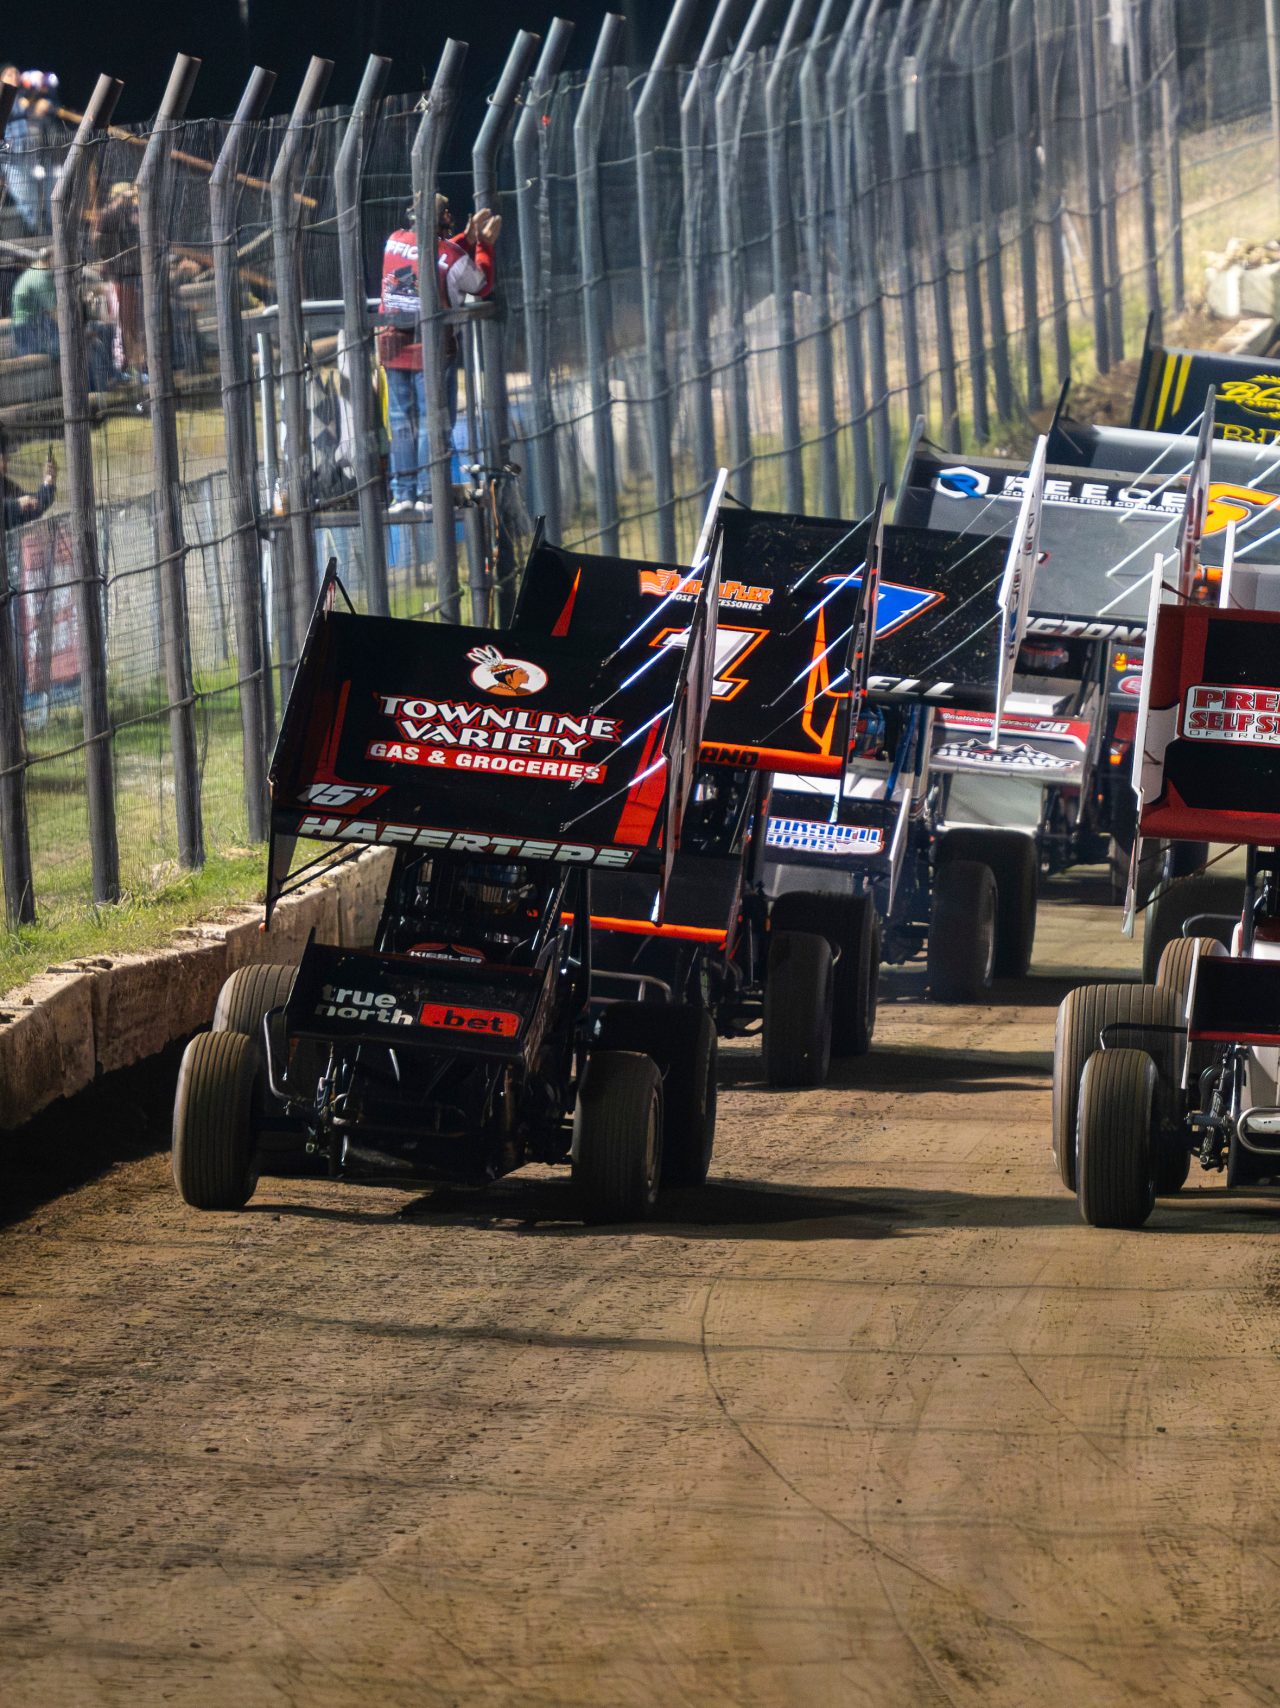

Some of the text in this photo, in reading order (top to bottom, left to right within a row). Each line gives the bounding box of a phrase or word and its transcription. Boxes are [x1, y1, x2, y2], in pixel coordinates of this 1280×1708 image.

[385, 240, 449, 269] FFICL
[1003, 476, 1187, 507] REECE
[1003, 490, 1111, 507] COTRUCTION
[380, 696, 622, 739] TOWNLINE
[1189, 711, 1255, 733] SELF
[401, 720, 587, 756] VARIETY
[370, 743, 600, 779] GAS & GROCERIES
[298, 817, 633, 868] HAFERTEPE
[322, 984, 397, 1008] true
[315, 1004, 414, 1026] north
